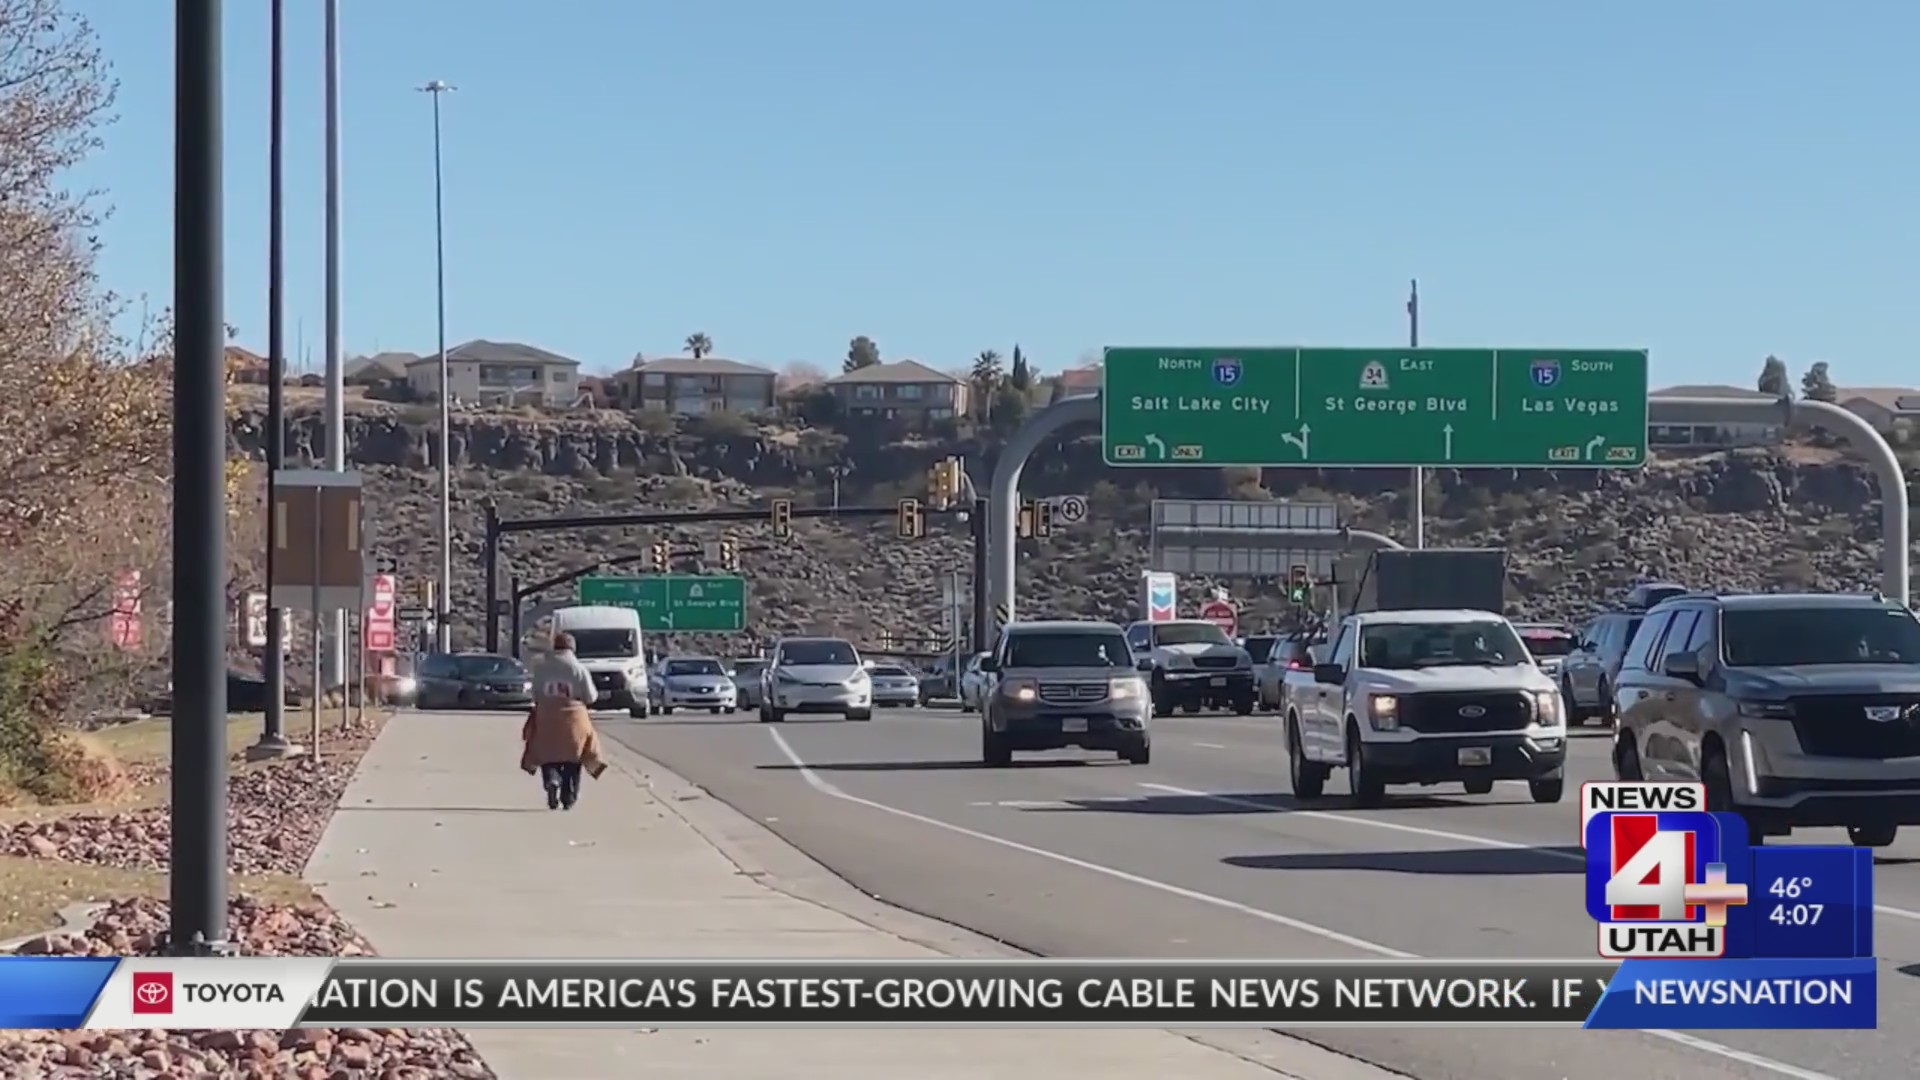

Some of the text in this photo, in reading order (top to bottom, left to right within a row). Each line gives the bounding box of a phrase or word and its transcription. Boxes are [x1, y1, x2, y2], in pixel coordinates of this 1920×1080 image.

[1400, 358, 1434, 371] EAST
[1571, 359, 1614, 371] SOUTH
[1219, 367, 1236, 382] 15
[1366, 368, 1383, 380] 34
[1538, 369, 1553, 384] 15
[1131, 396, 1270, 414] Salt Lake City
[1325, 397, 1467, 416] St George Blvd
[1522, 398, 1619, 416] Las Vegas
[1117, 446, 1142, 457] EXIT
[1173, 446, 1201, 457] ONLY
